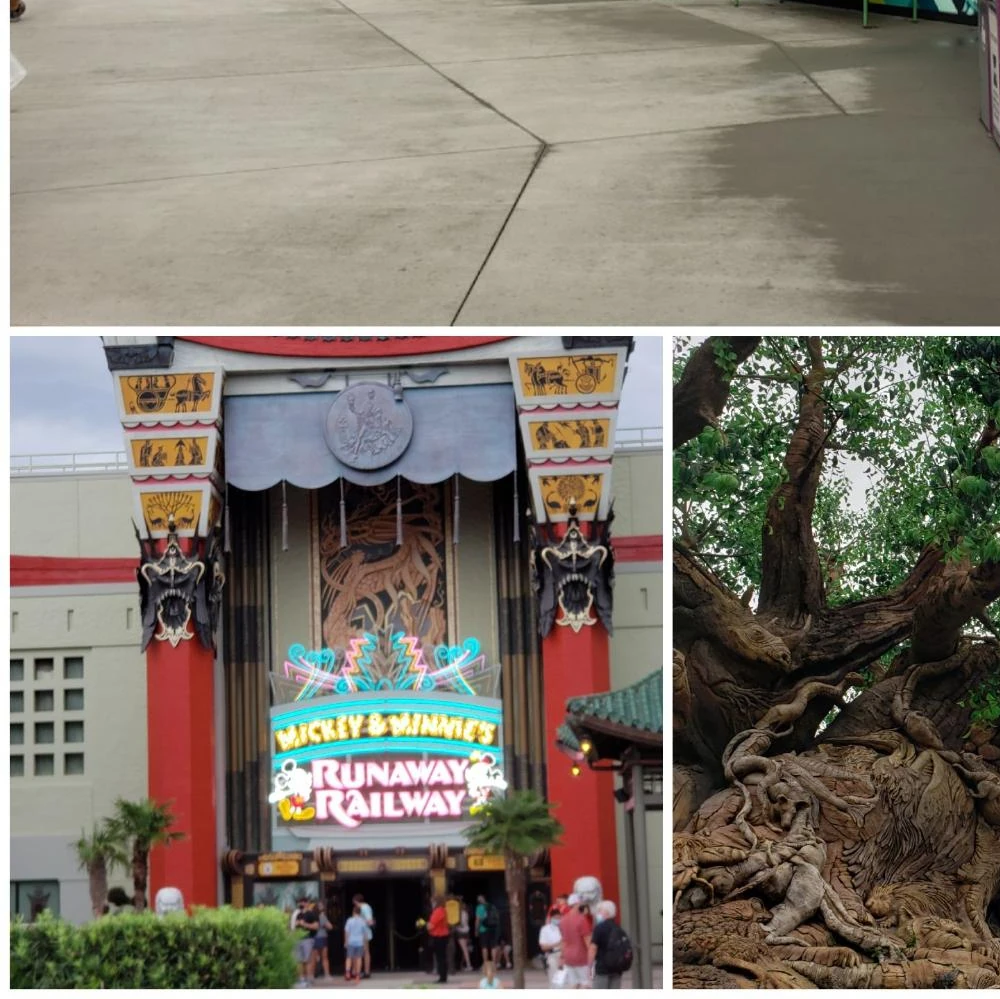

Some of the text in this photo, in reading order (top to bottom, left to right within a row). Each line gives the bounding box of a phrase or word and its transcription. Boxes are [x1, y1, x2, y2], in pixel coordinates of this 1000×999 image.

[274, 711, 497, 752] MICKEY & MINNIE'S
[310, 758, 470, 790] RUNAWAY
[314, 789, 467, 829] RAILWAY
